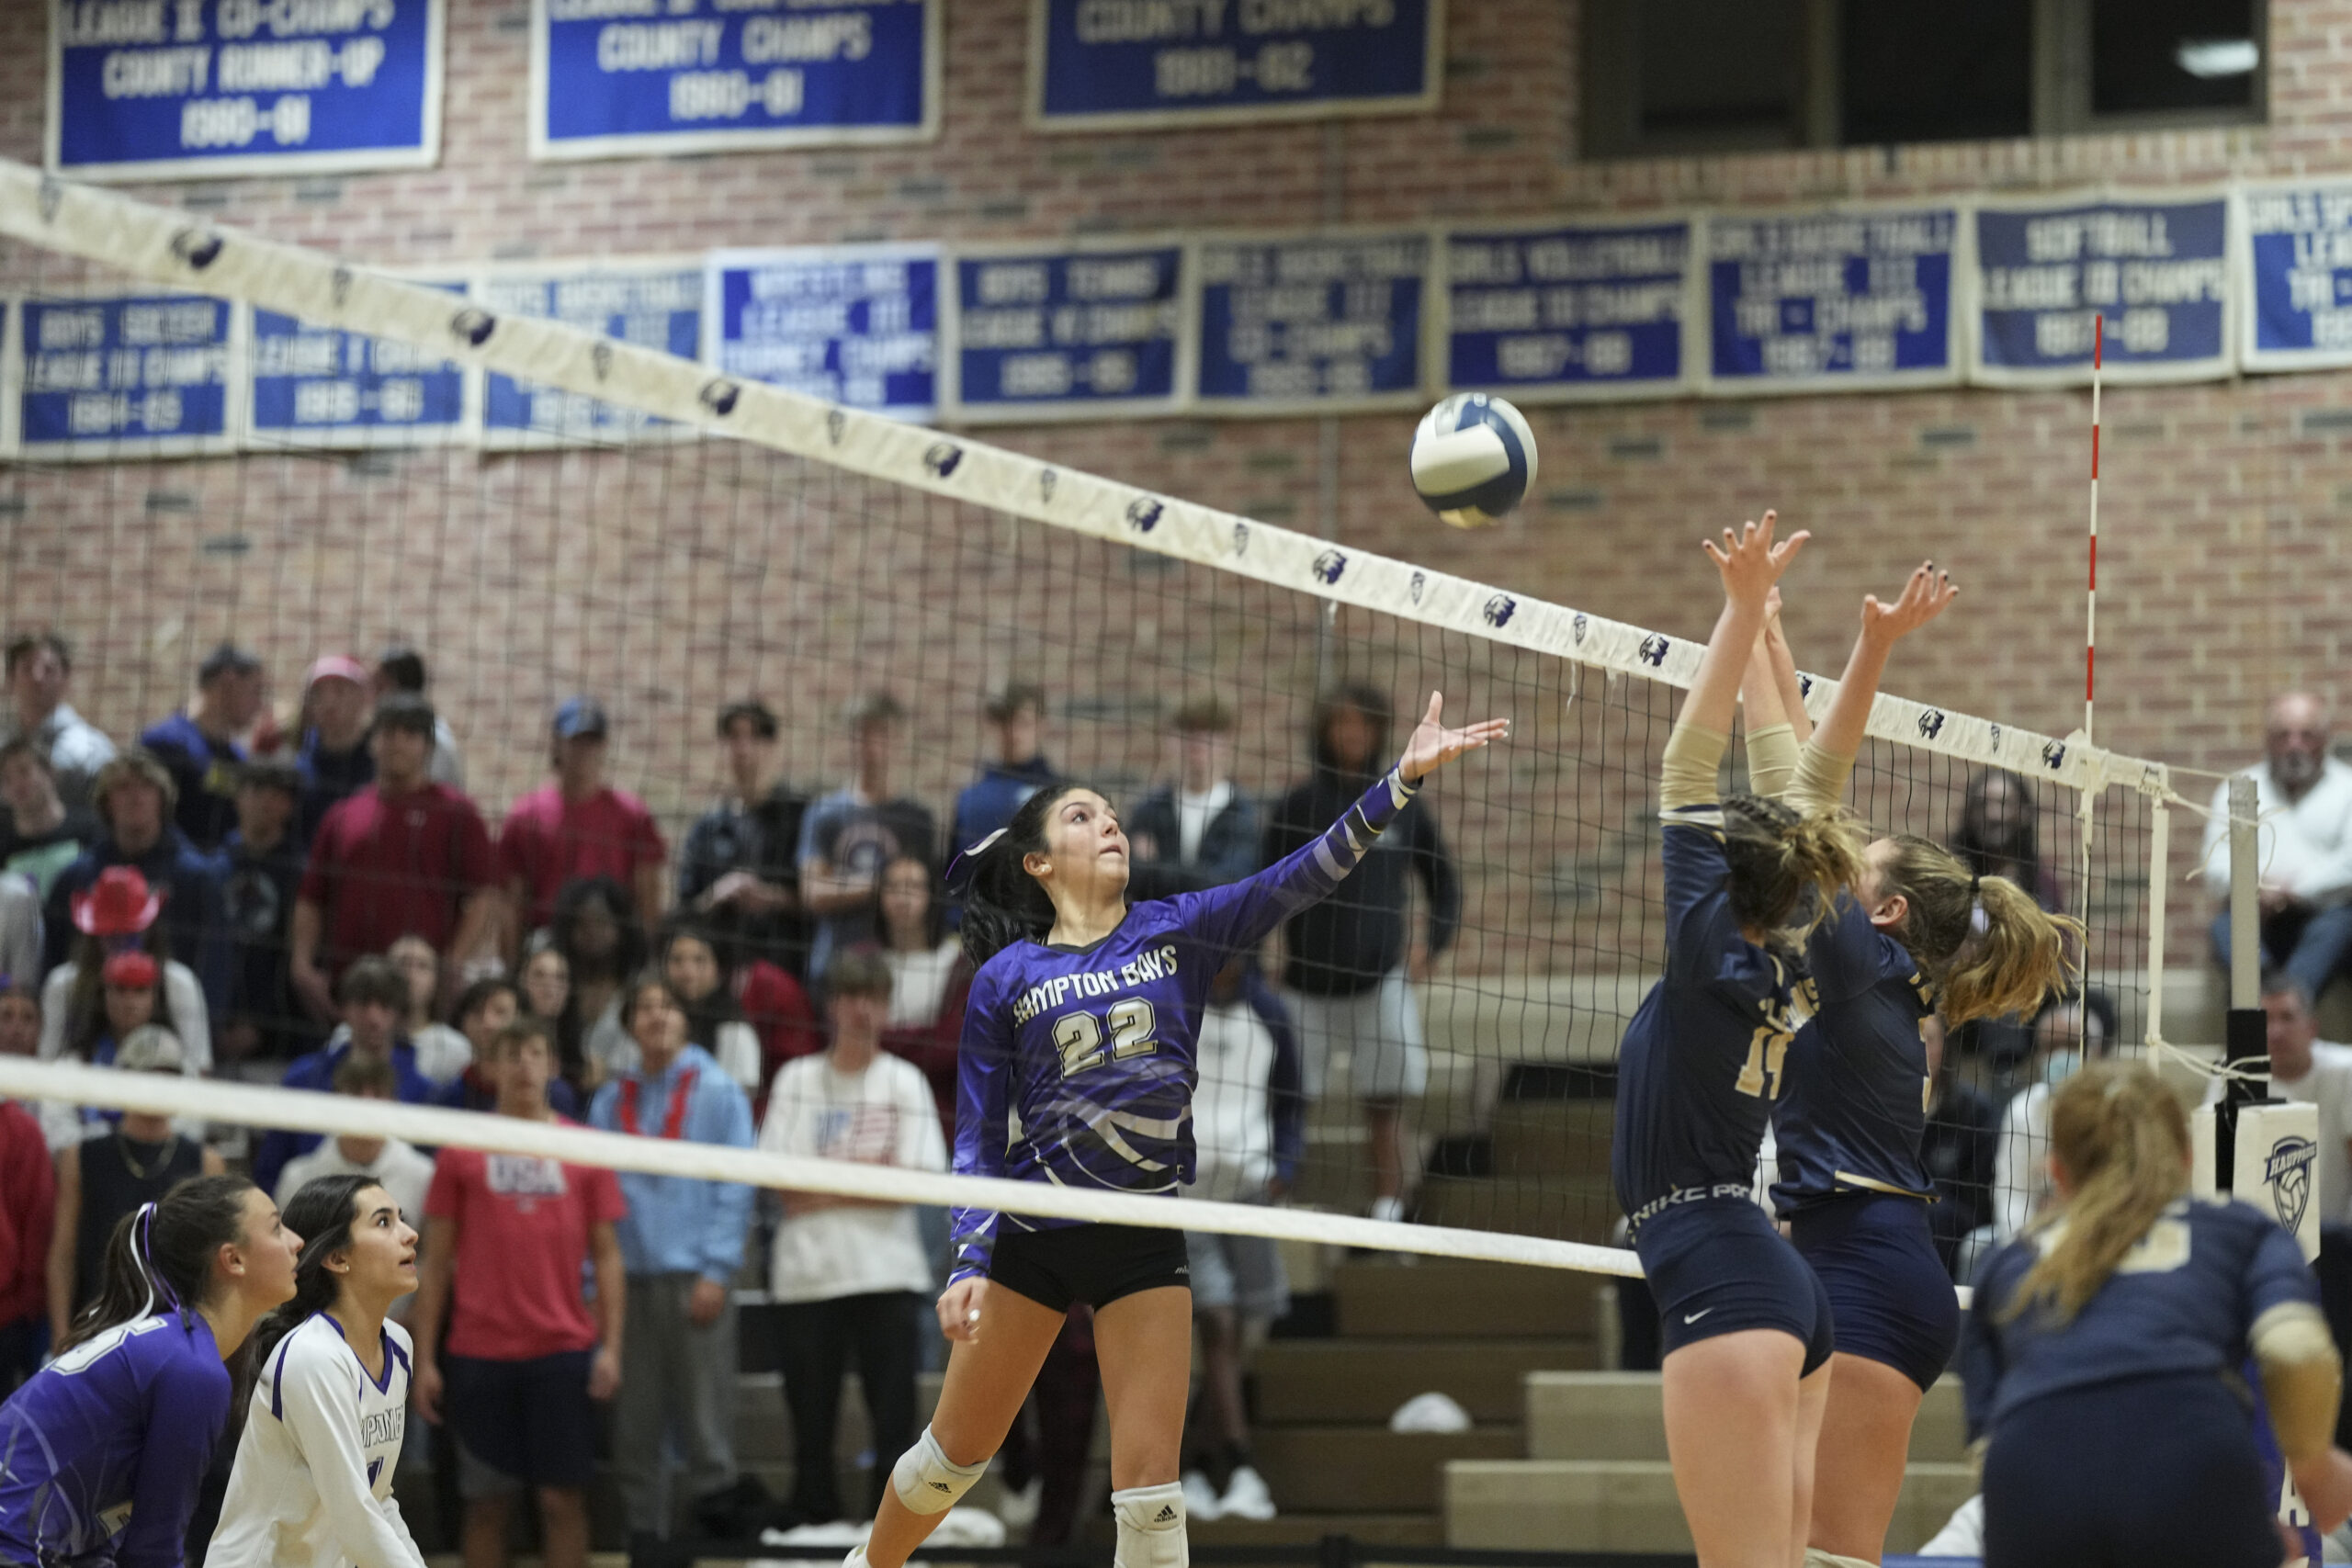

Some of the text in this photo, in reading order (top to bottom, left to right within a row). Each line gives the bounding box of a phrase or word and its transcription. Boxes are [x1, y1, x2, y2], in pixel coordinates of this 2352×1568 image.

[103, 46, 211, 98] COUNTY
[596, 11, 874, 73] COUNTY CHAMPS
[1013, 944, 1178, 1028] HAMPTON BAYS
[1051, 996, 1159, 1081] 22
